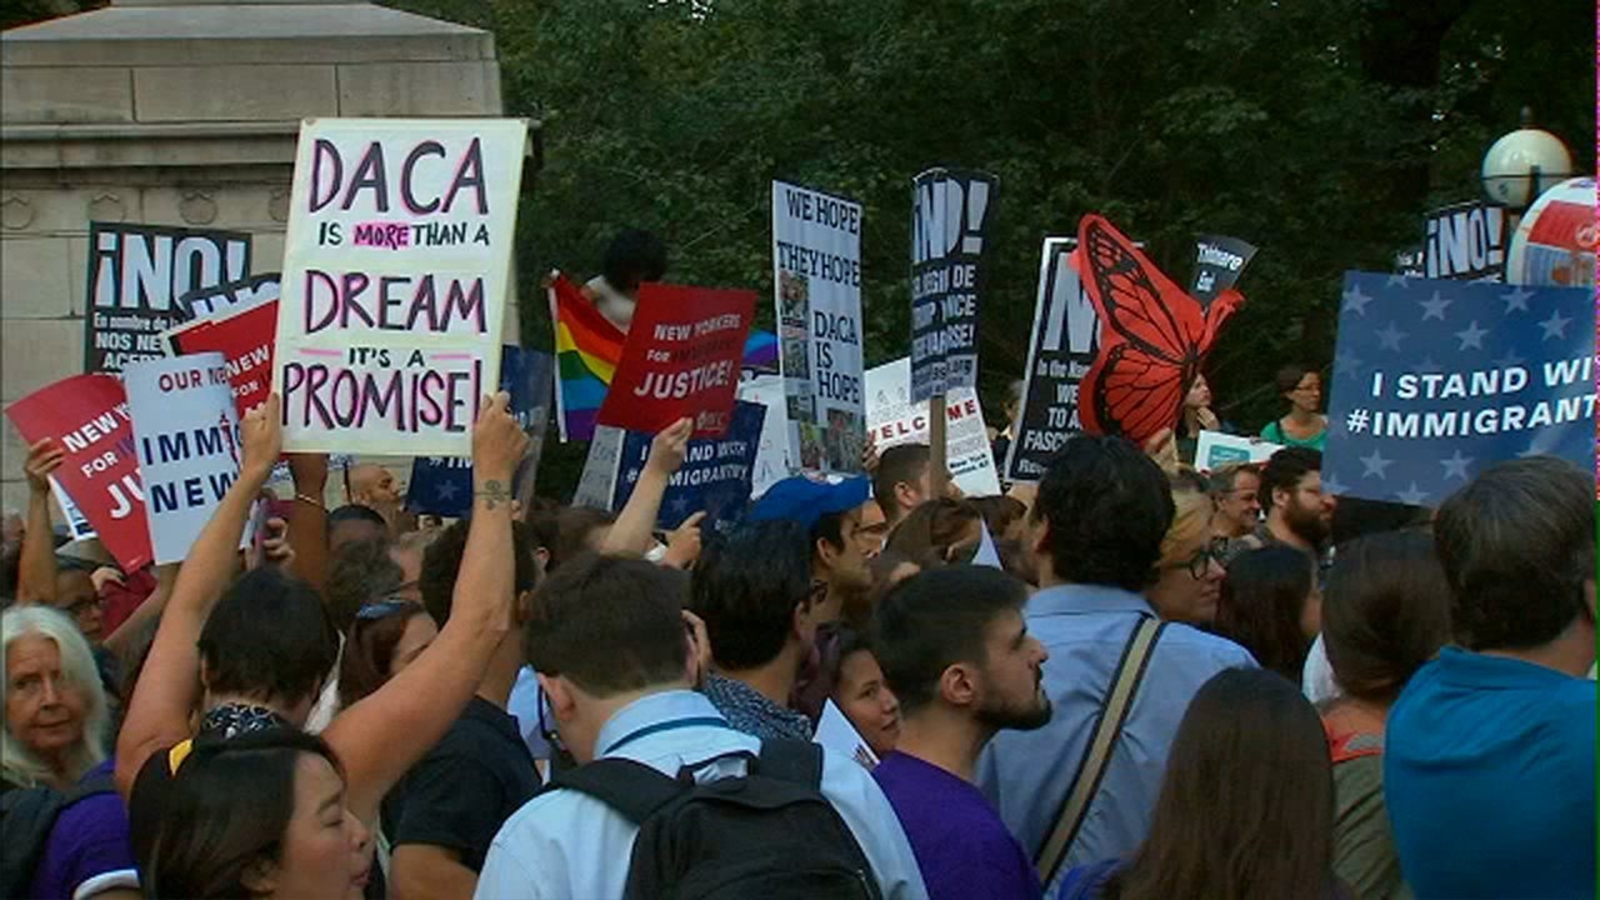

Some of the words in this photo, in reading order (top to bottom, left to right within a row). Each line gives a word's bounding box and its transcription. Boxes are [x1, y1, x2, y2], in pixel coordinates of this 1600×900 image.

[308, 137, 489, 216] DACA
[787, 189, 812, 221] WE
[815, 196, 859, 235] HOPE
[318, 222, 342, 246] IS
[353, 224, 409, 250] MORE
[412, 222, 467, 246] THAN
[473, 224, 490, 246] A
[1427, 207, 1503, 279] ¡NO!
[777, 241, 818, 276] THEY
[821, 252, 861, 288] HOPE
[305, 270, 487, 334] DREAM
[95, 332, 131, 352] NOS
[654, 324, 692, 341] NEW
[813, 311, 858, 346] DACA
[225, 344, 271, 378] NEW
[350, 348, 391, 367] IT'S
[407, 350, 425, 367] A
[816, 342, 833, 369] IS
[159, 369, 202, 392] OUR
[282, 359, 481, 433] PROMISE!
[633, 360, 734, 398] JUSTICE!
[818, 370, 860, 404] HOPE
[1372, 372, 1383, 397] I
[1397, 366, 1530, 398] STAND
[62, 412, 118, 453] NEW
[1048, 407, 1067, 428] TO
[81, 451, 119, 479] FOR
